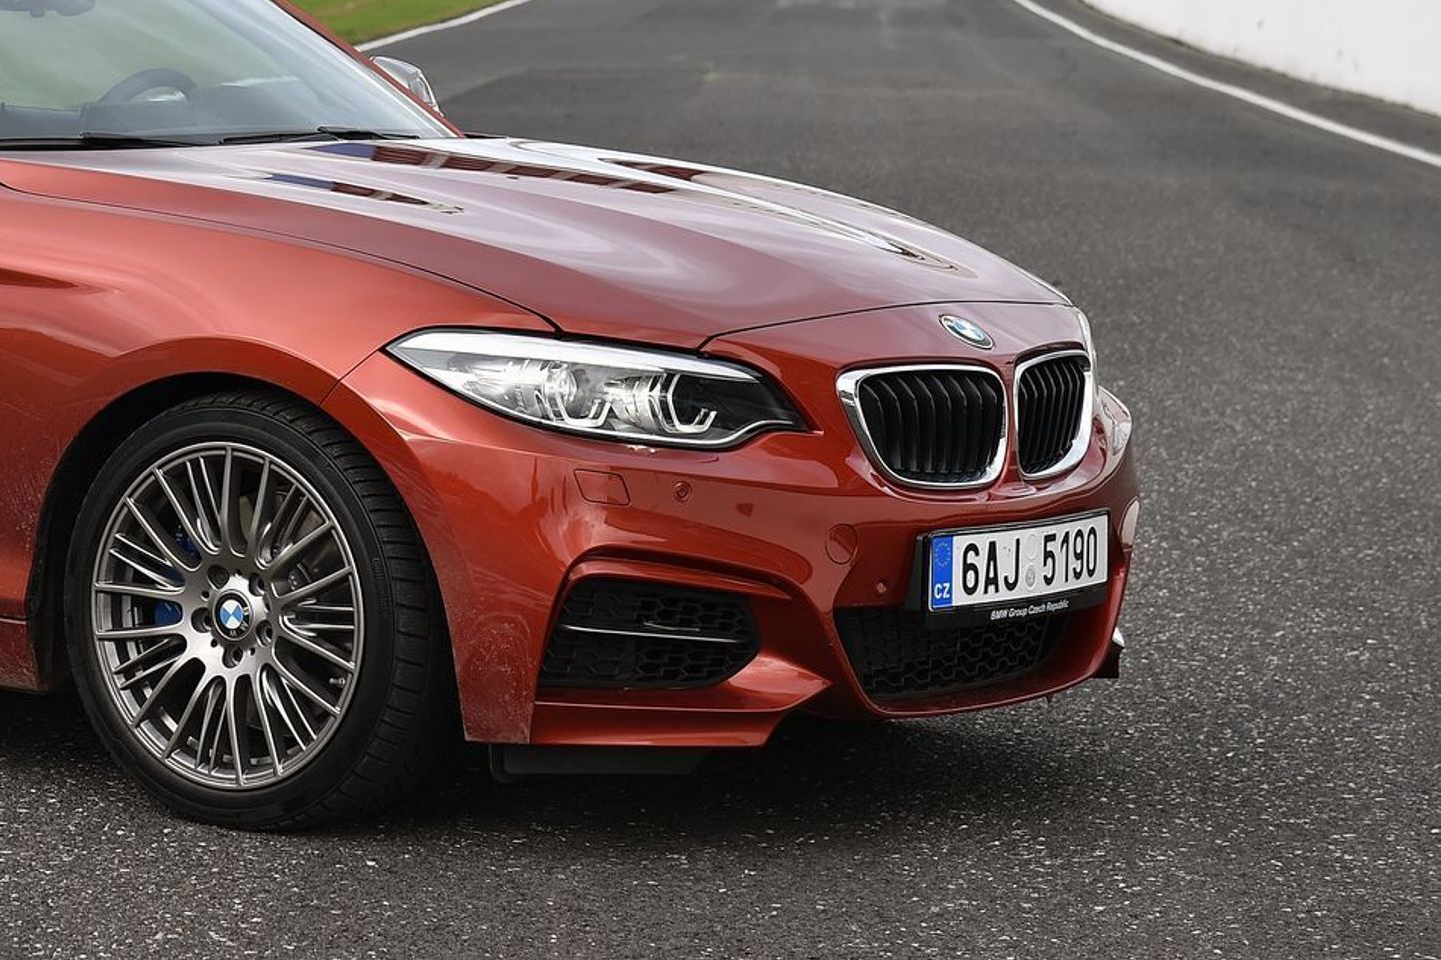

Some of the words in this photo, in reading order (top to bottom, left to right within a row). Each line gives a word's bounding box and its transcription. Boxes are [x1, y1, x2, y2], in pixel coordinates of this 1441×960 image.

[961, 537, 1021, 596] 6AJ
[1042, 525, 1099, 587] 5190
[934, 583, 950, 599] CZ
[990, 609, 1008, 620] BMW
[1008, 607, 1028, 618] Group
[1028, 603, 1046, 615] Czech
[1046, 599, 1069, 613] Republic
